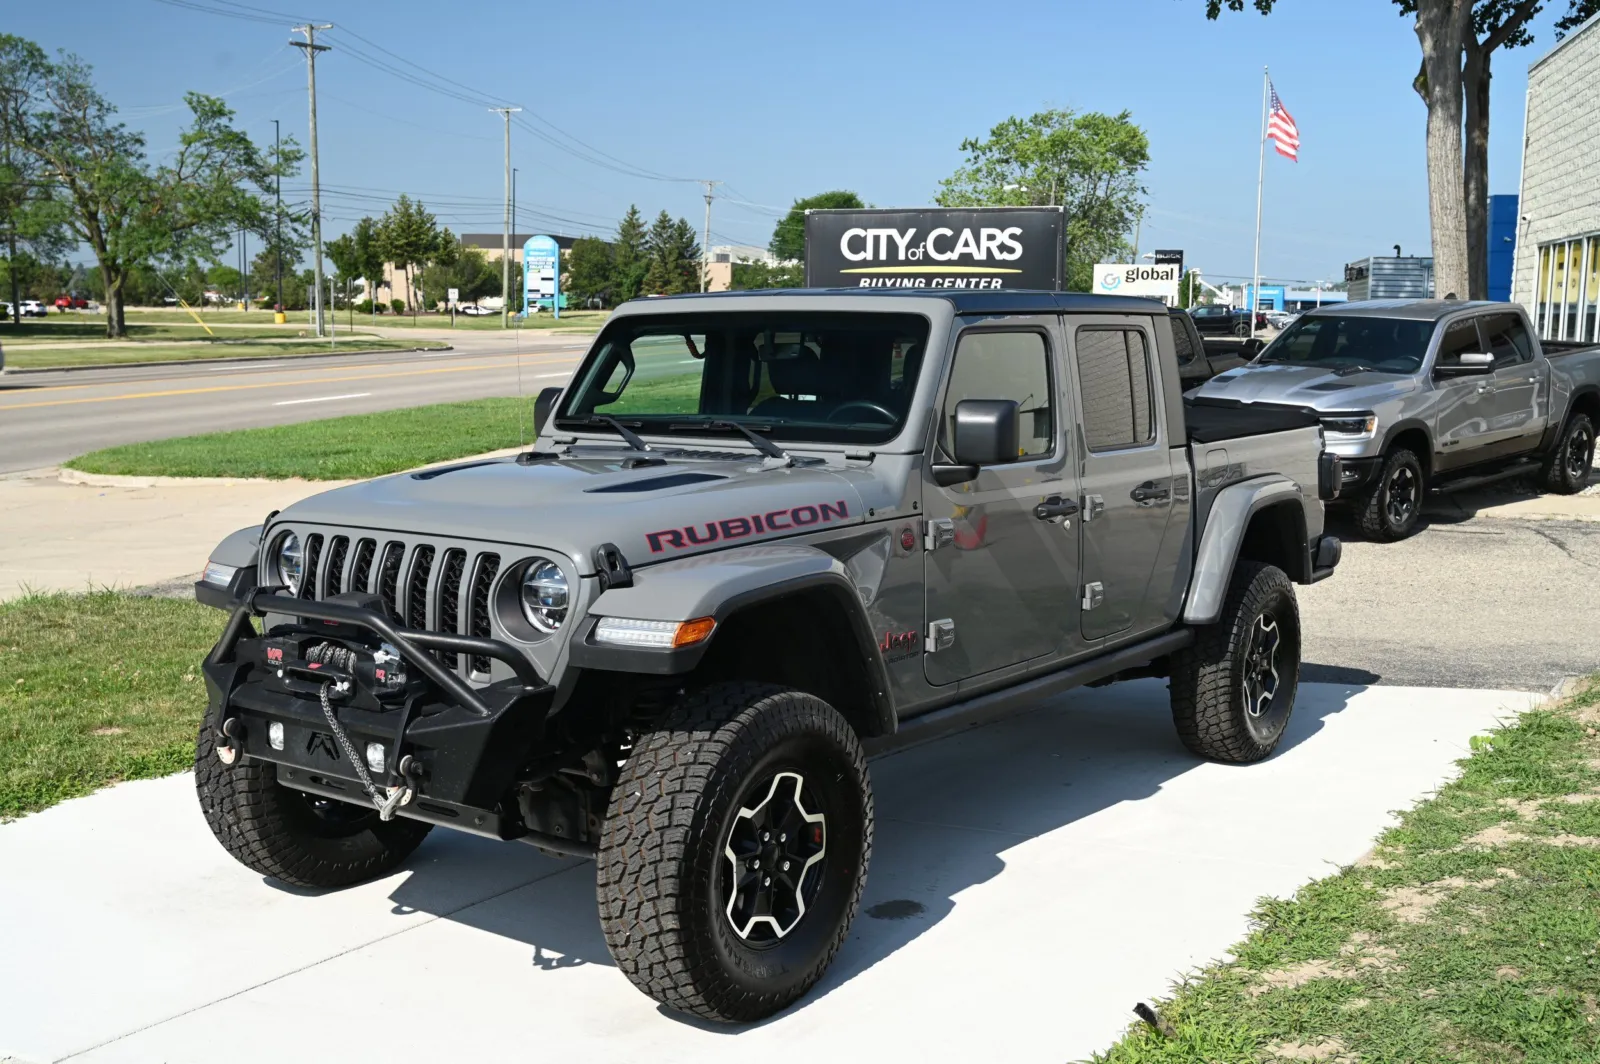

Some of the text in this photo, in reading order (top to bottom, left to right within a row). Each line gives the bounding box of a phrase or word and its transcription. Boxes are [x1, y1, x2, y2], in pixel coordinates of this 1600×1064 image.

[840, 227, 1023, 261] CITY of CARS
[1125, 267, 1174, 283] global
[646, 500, 849, 553] RUBICON
